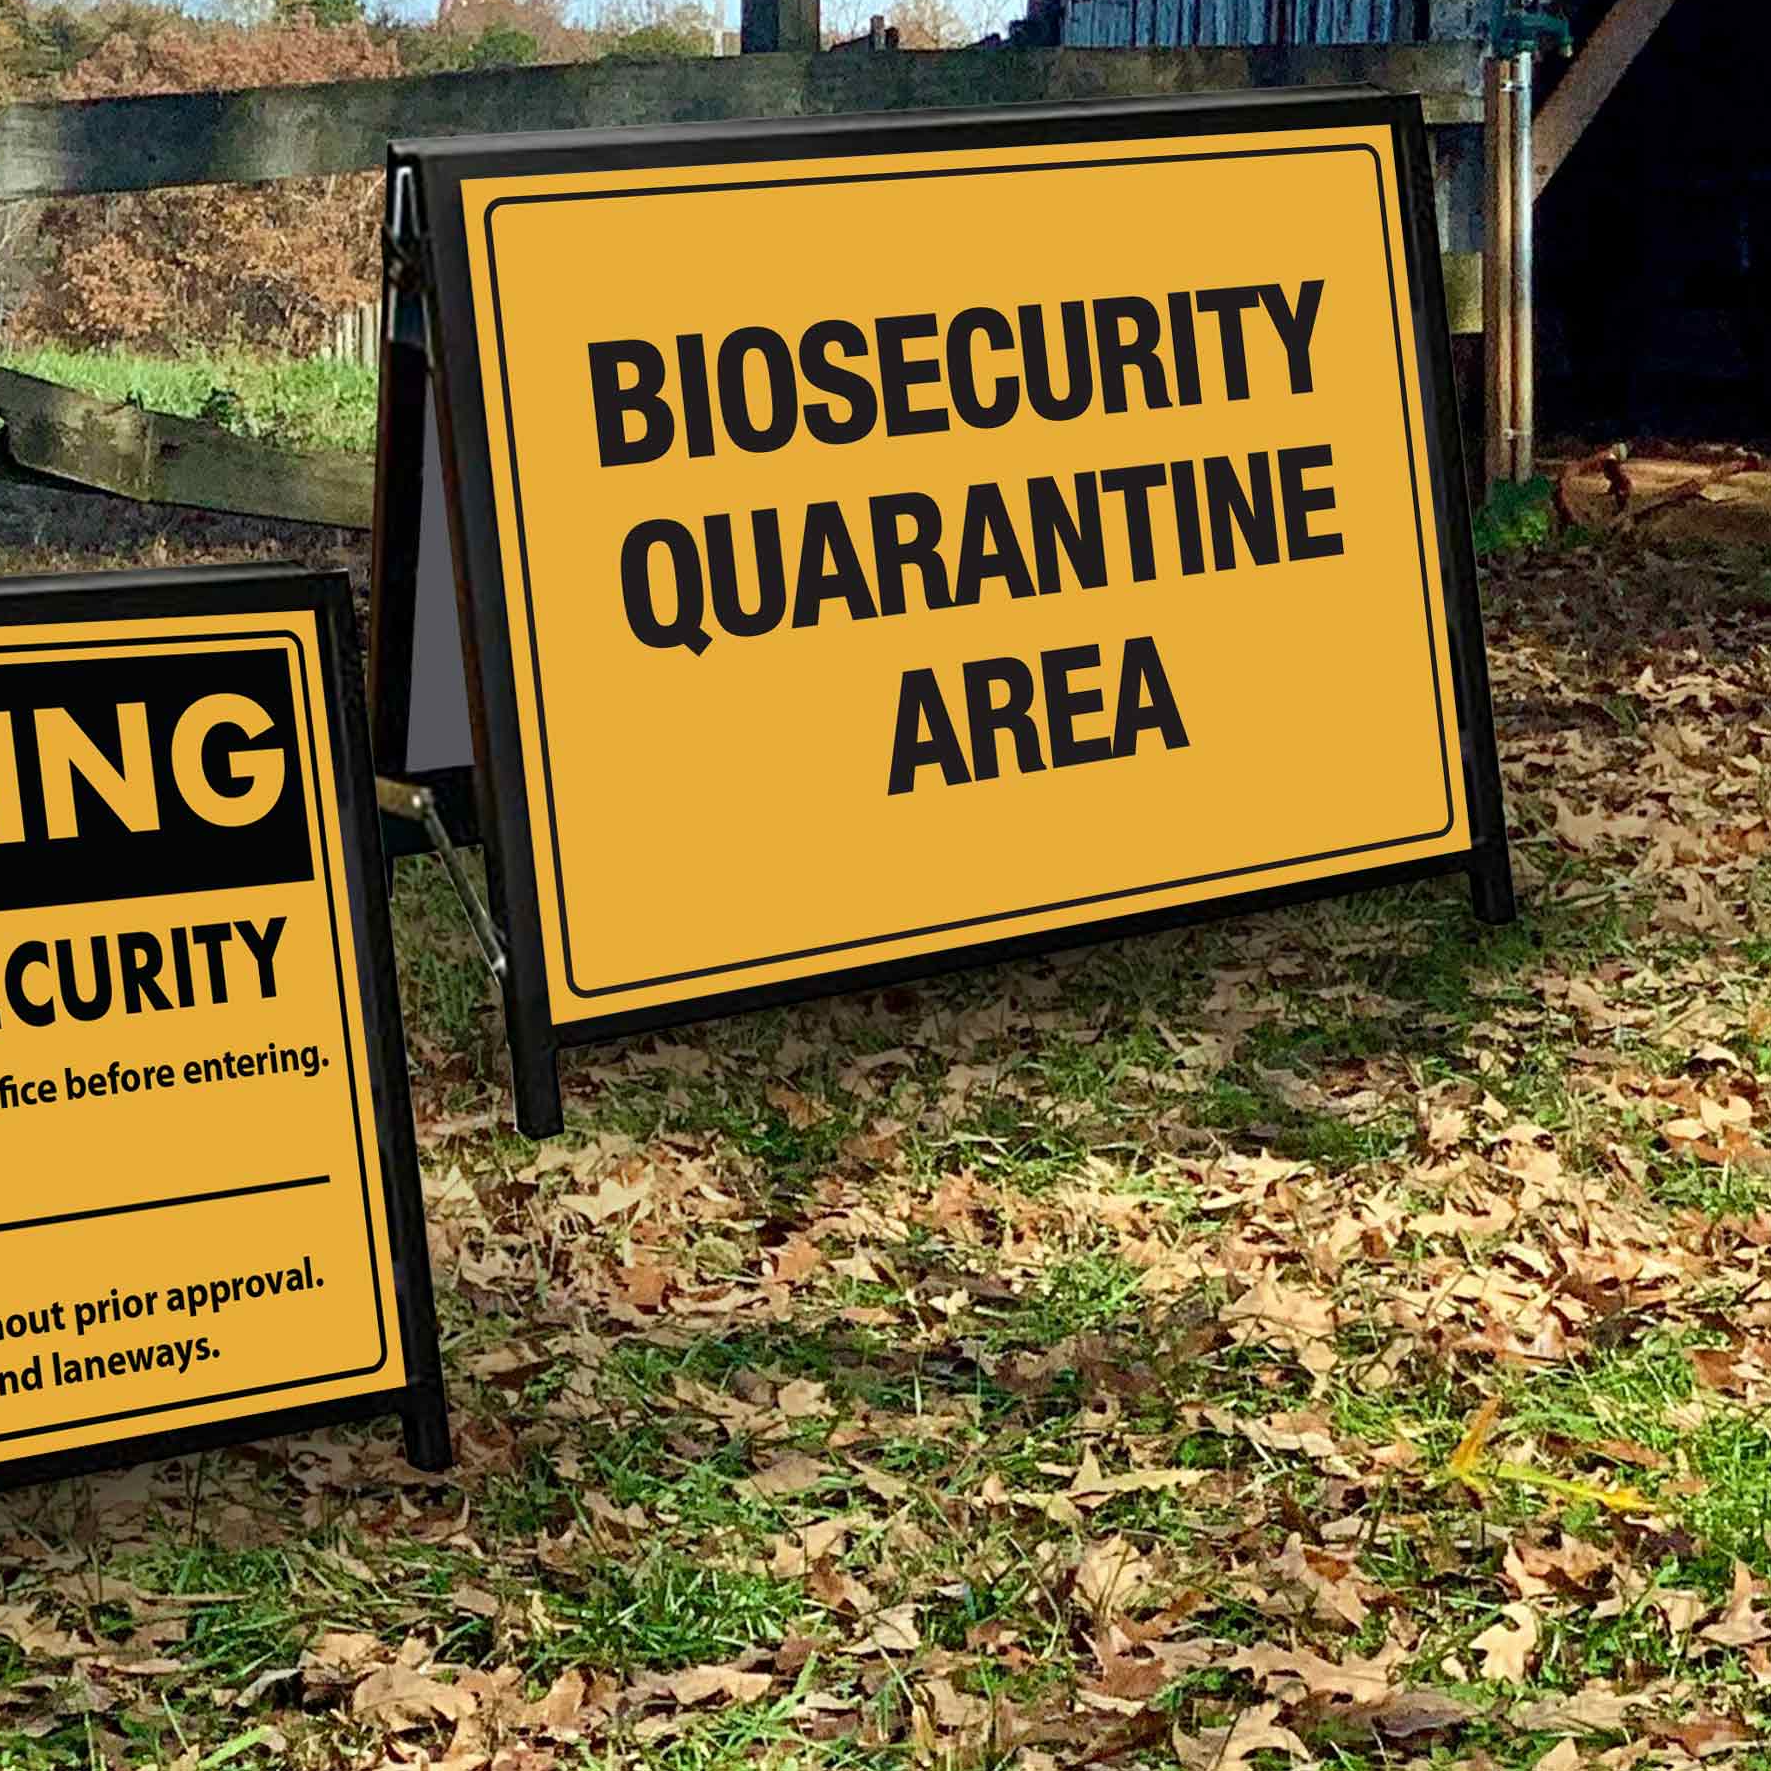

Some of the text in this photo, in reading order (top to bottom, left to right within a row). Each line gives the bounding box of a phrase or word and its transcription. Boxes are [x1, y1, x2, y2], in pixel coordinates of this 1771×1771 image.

[588, 280, 1324, 467] BIOSECURITY
[621, 444, 1344, 656] QUARANTINE
[888, 636, 1189, 795] AREA
[65, 1061, 174, 1100] before
[184, 1043, 329, 1084] entering.
[75, 1289, 157, 1335] prior
[167, 1256, 323, 1316] approval.
[52, 1338, 220, 1386] laneways.
